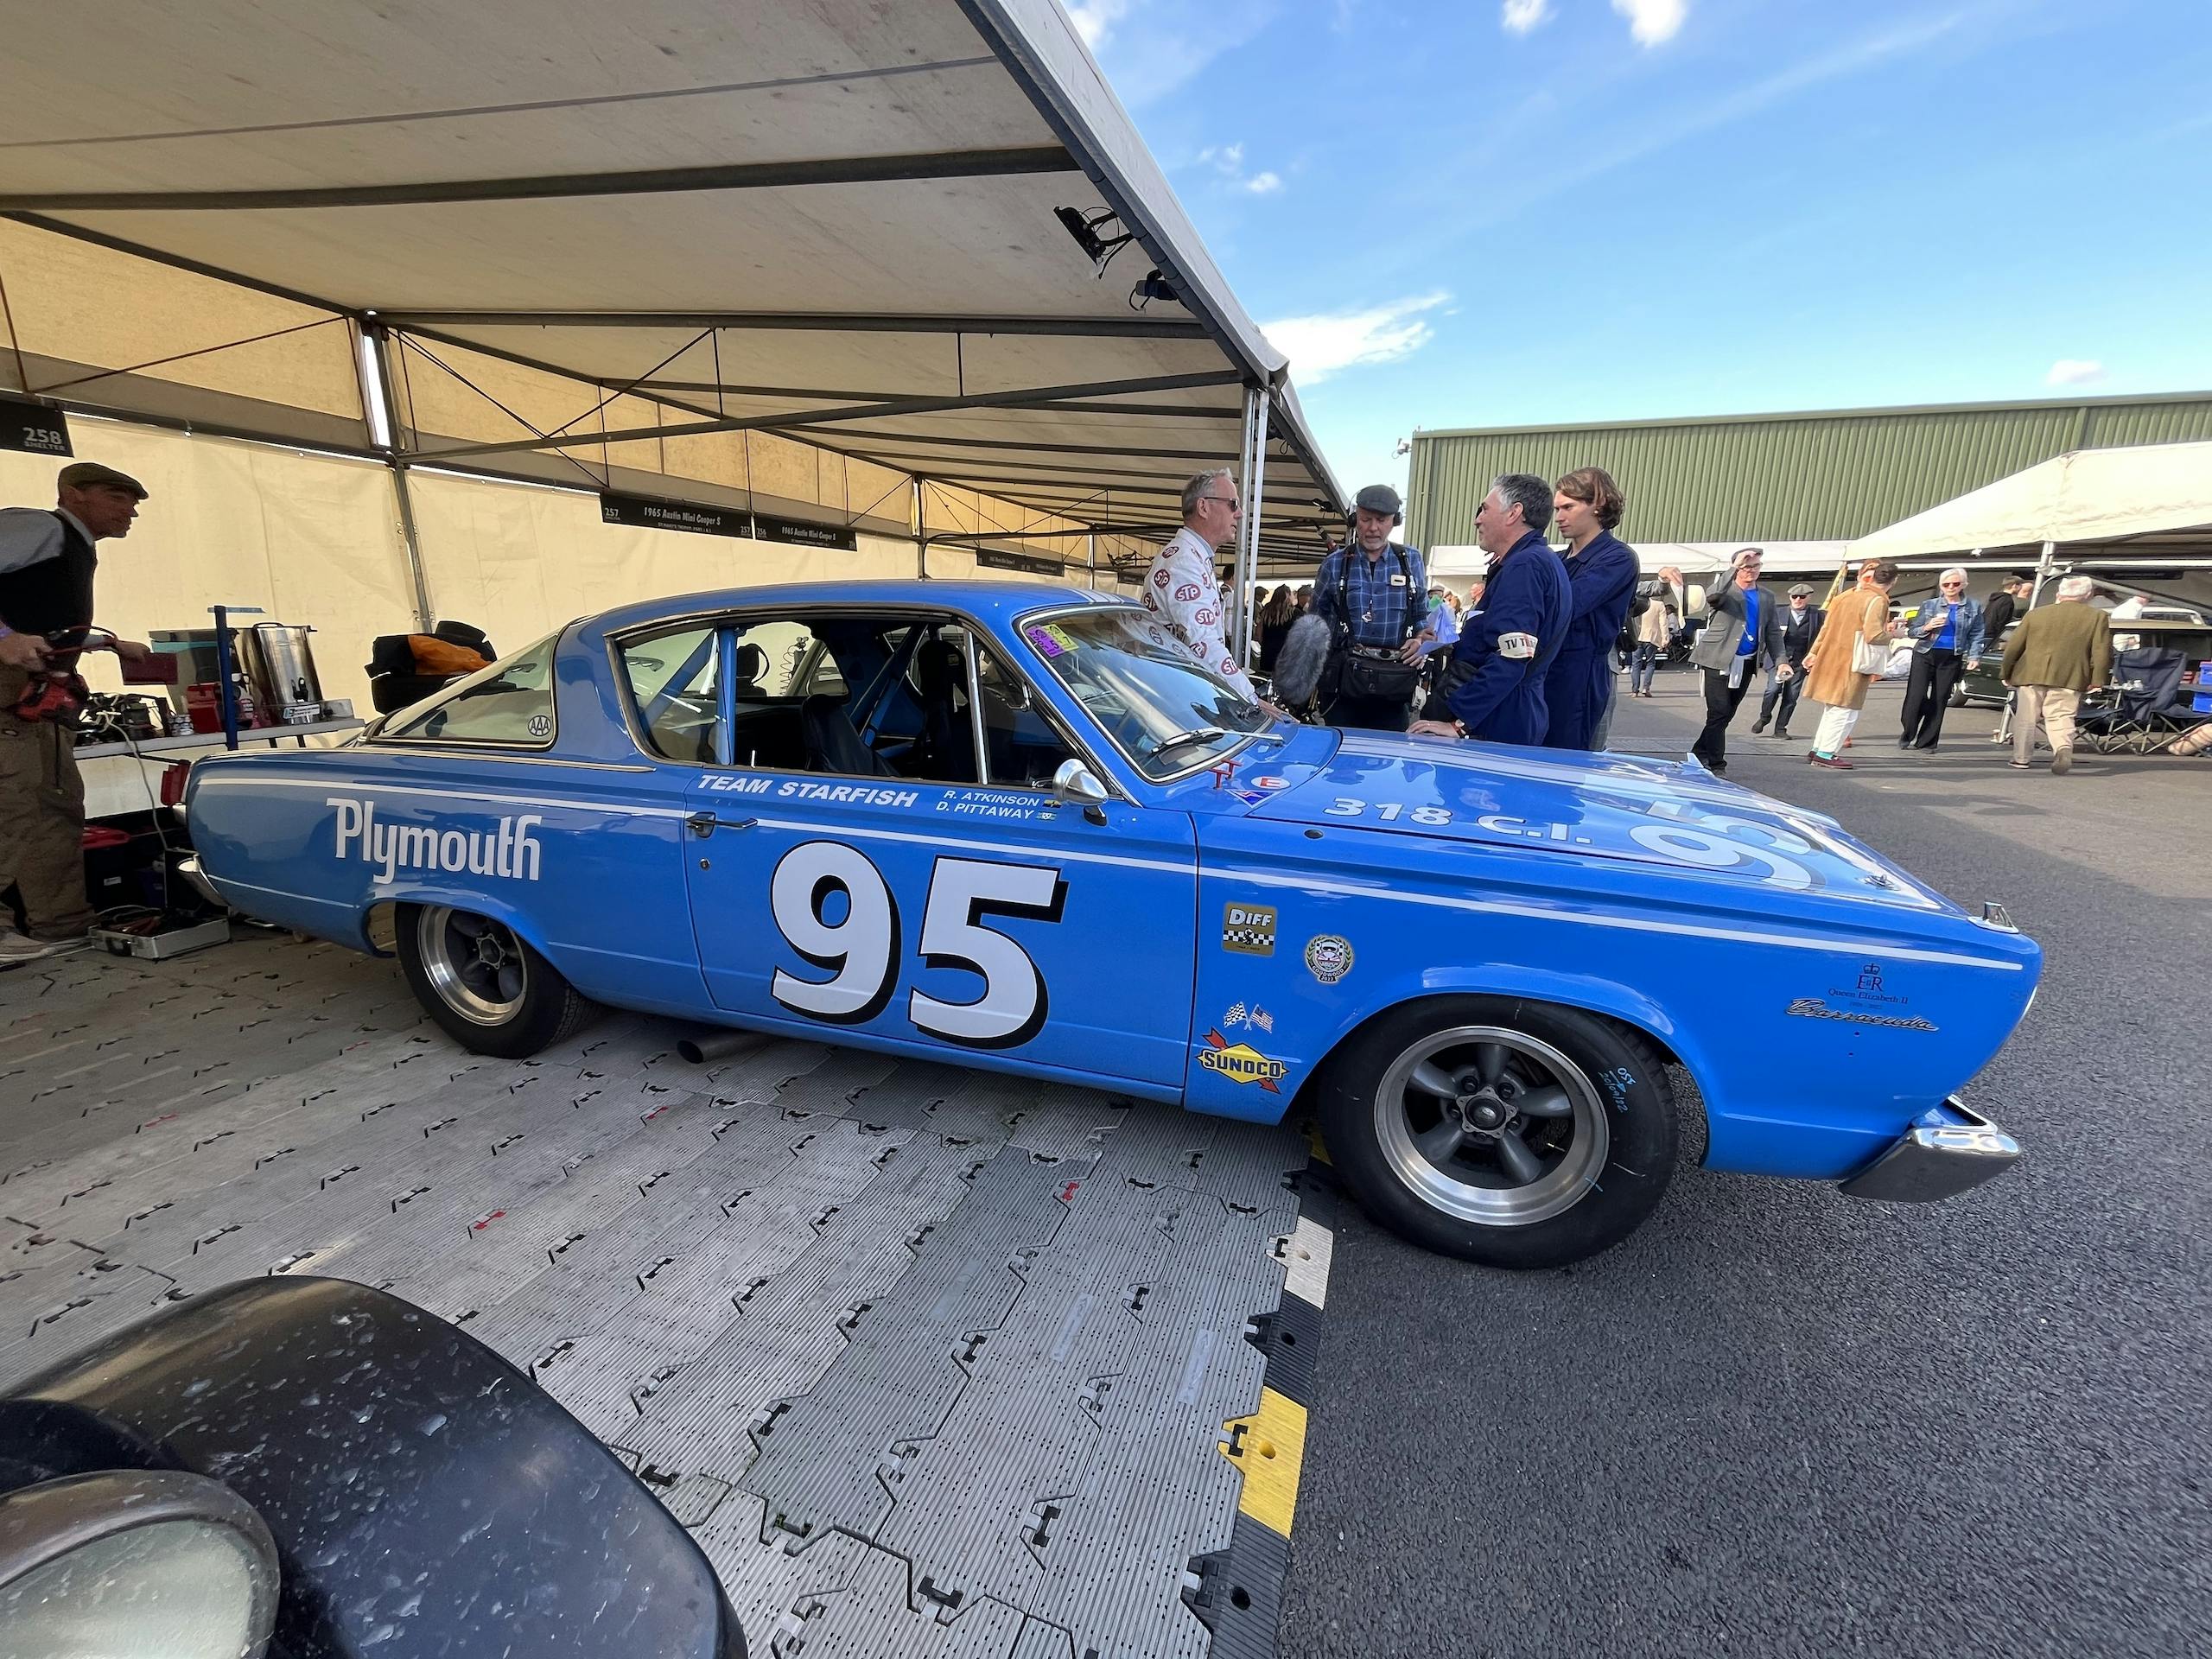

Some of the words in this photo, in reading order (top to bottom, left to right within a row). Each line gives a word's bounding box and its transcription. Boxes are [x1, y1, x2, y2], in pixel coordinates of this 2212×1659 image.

[22, 427, 62, 444] 258
[605, 507, 620, 518] 257
[644, 506, 661, 518] 1965
[662, 509, 681, 520] Austin
[682, 512, 696, 522] Mini
[696, 513, 715, 526] Cooper
[716, 517, 721, 526] S
[740, 525, 751, 534] 257
[781, 526, 793, 535] 1965
[1154, 571, 1169, 586] STP
[1177, 586, 1198, 601] STP
[530, 716, 550, 735] AAA
[697, 774, 773, 794] TEAM
[778, 782, 918, 808] STARFISH
[944, 790, 957, 799] R.
[961, 791, 1039, 807] ATKINSON
[936, 801, 950, 811] D.
[954, 803, 1034, 819] PITTAWAY
[1323, 798, 1452, 825] 318
[1477, 815, 1592, 844] C.I.
[326, 798, 543, 884] Plymouth
[771, 839, 1070, 1050] 95
[1312, 965, 1344, 977] GOODWOOD
[1828, 988, 1856, 998] Queen
[1859, 991, 1899, 1003] Elizabeth
[1786, 998, 1940, 1031] Barracuda
[1204, 1052, 1281, 1077] SUNOCO
